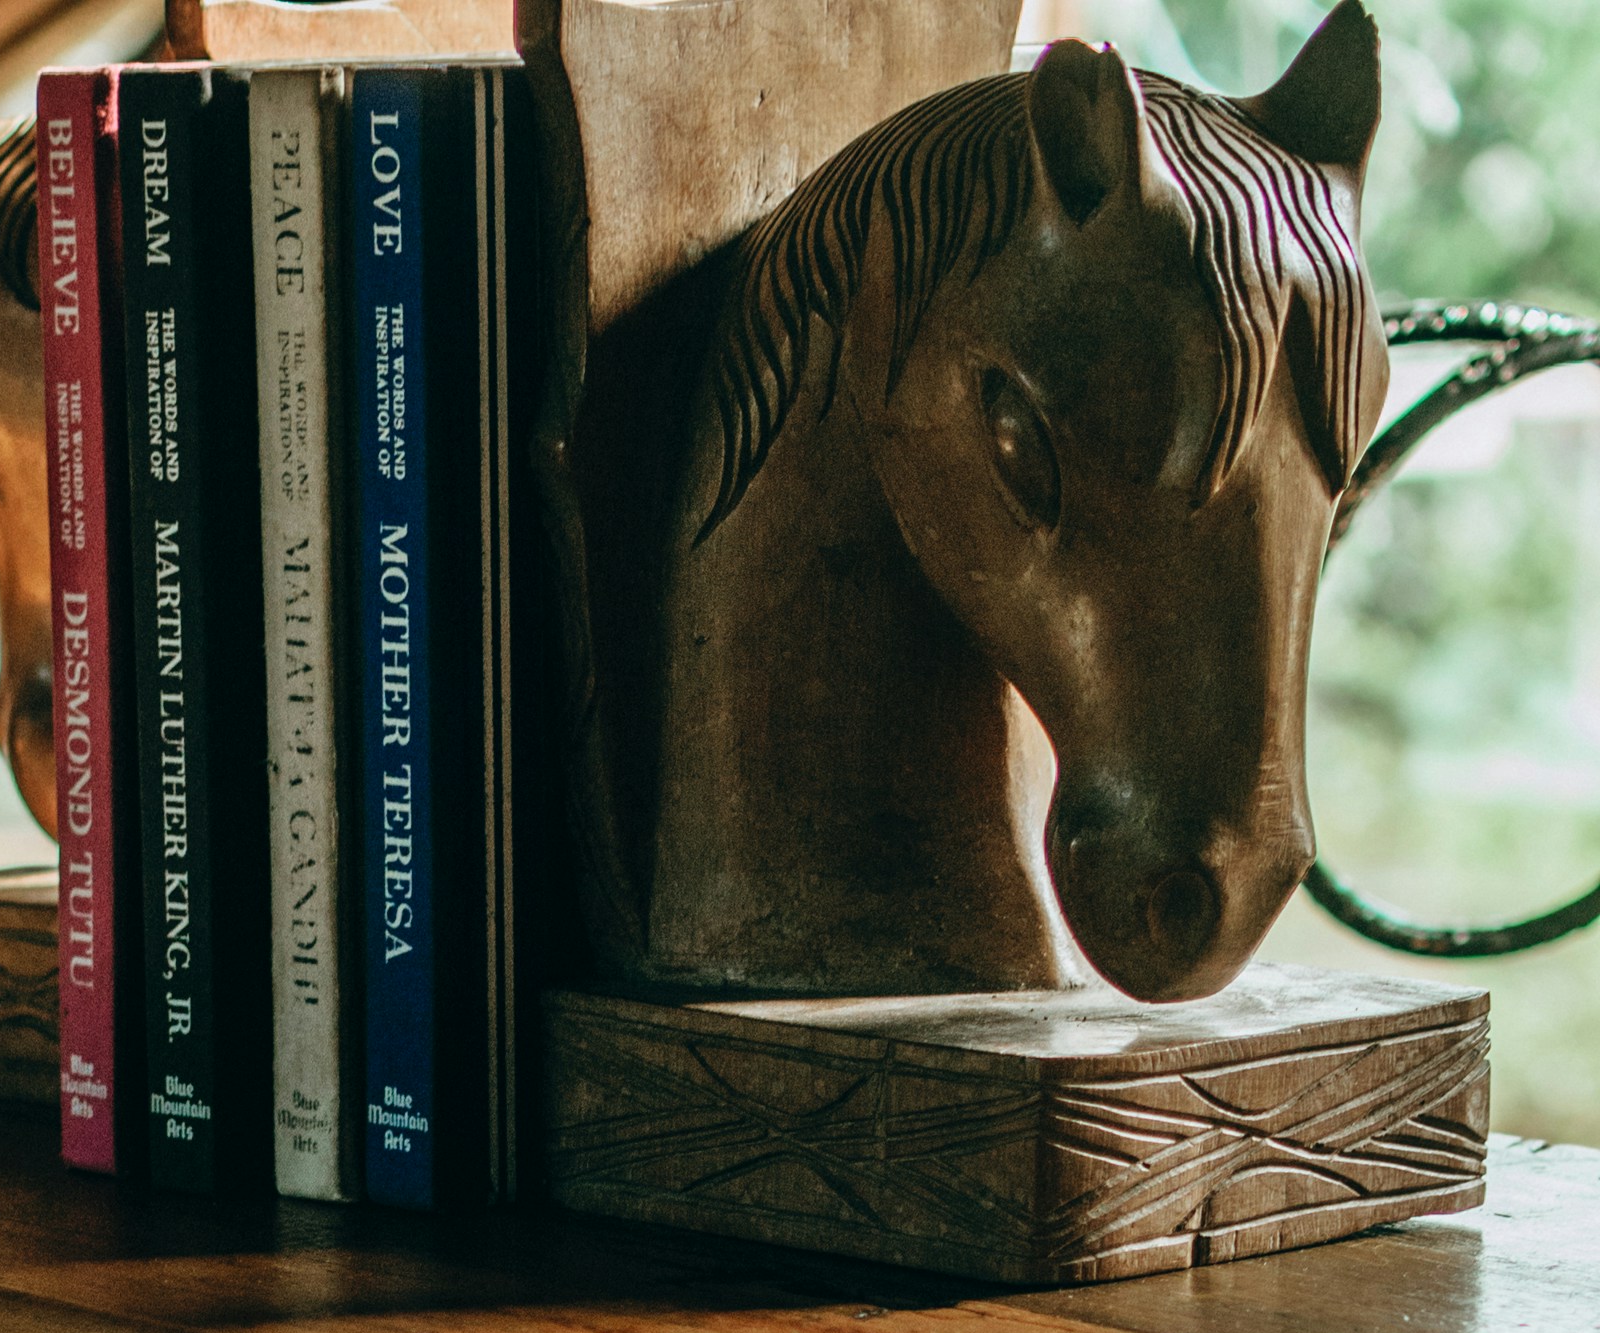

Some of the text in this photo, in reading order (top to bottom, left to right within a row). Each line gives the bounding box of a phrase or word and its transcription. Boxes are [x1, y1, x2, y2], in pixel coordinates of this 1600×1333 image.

[47, 117, 80, 336] BELIEVE
[141, 118, 172, 267] DREAM
[271, 129, 306, 297] PEACE
[369, 110, 403, 256] LOVE
[56, 382, 73, 547] INSPIRATION OF
[70, 380, 86, 550] THE WORDS AND
[145, 310, 164, 481] INSPIRATION OF
[161, 307, 180, 483] THE WORDS AND
[375, 306, 391, 479] INSPIRATION OF
[392, 303, 407, 481] THE WORDS AND
[61, 591, 95, 992] DESMOND TUTU
[154, 519, 193, 1044] MARTIN LUTHER KING, JR.
[378, 522, 414, 964] MOTHER TERESA
[61, 1073, 108, 1100] Mountain
[70, 1054, 95, 1078] Blue
[70, 1096, 95, 1119] Arts
[151, 1097, 211, 1121] Mountain
[165, 1075, 194, 1100] Blue
[166, 1119, 194, 1142] Arts
[367, 1106, 429, 1133] Mountain
[383, 1086, 413, 1110] Blue
[383, 1130, 412, 1153] Arts
